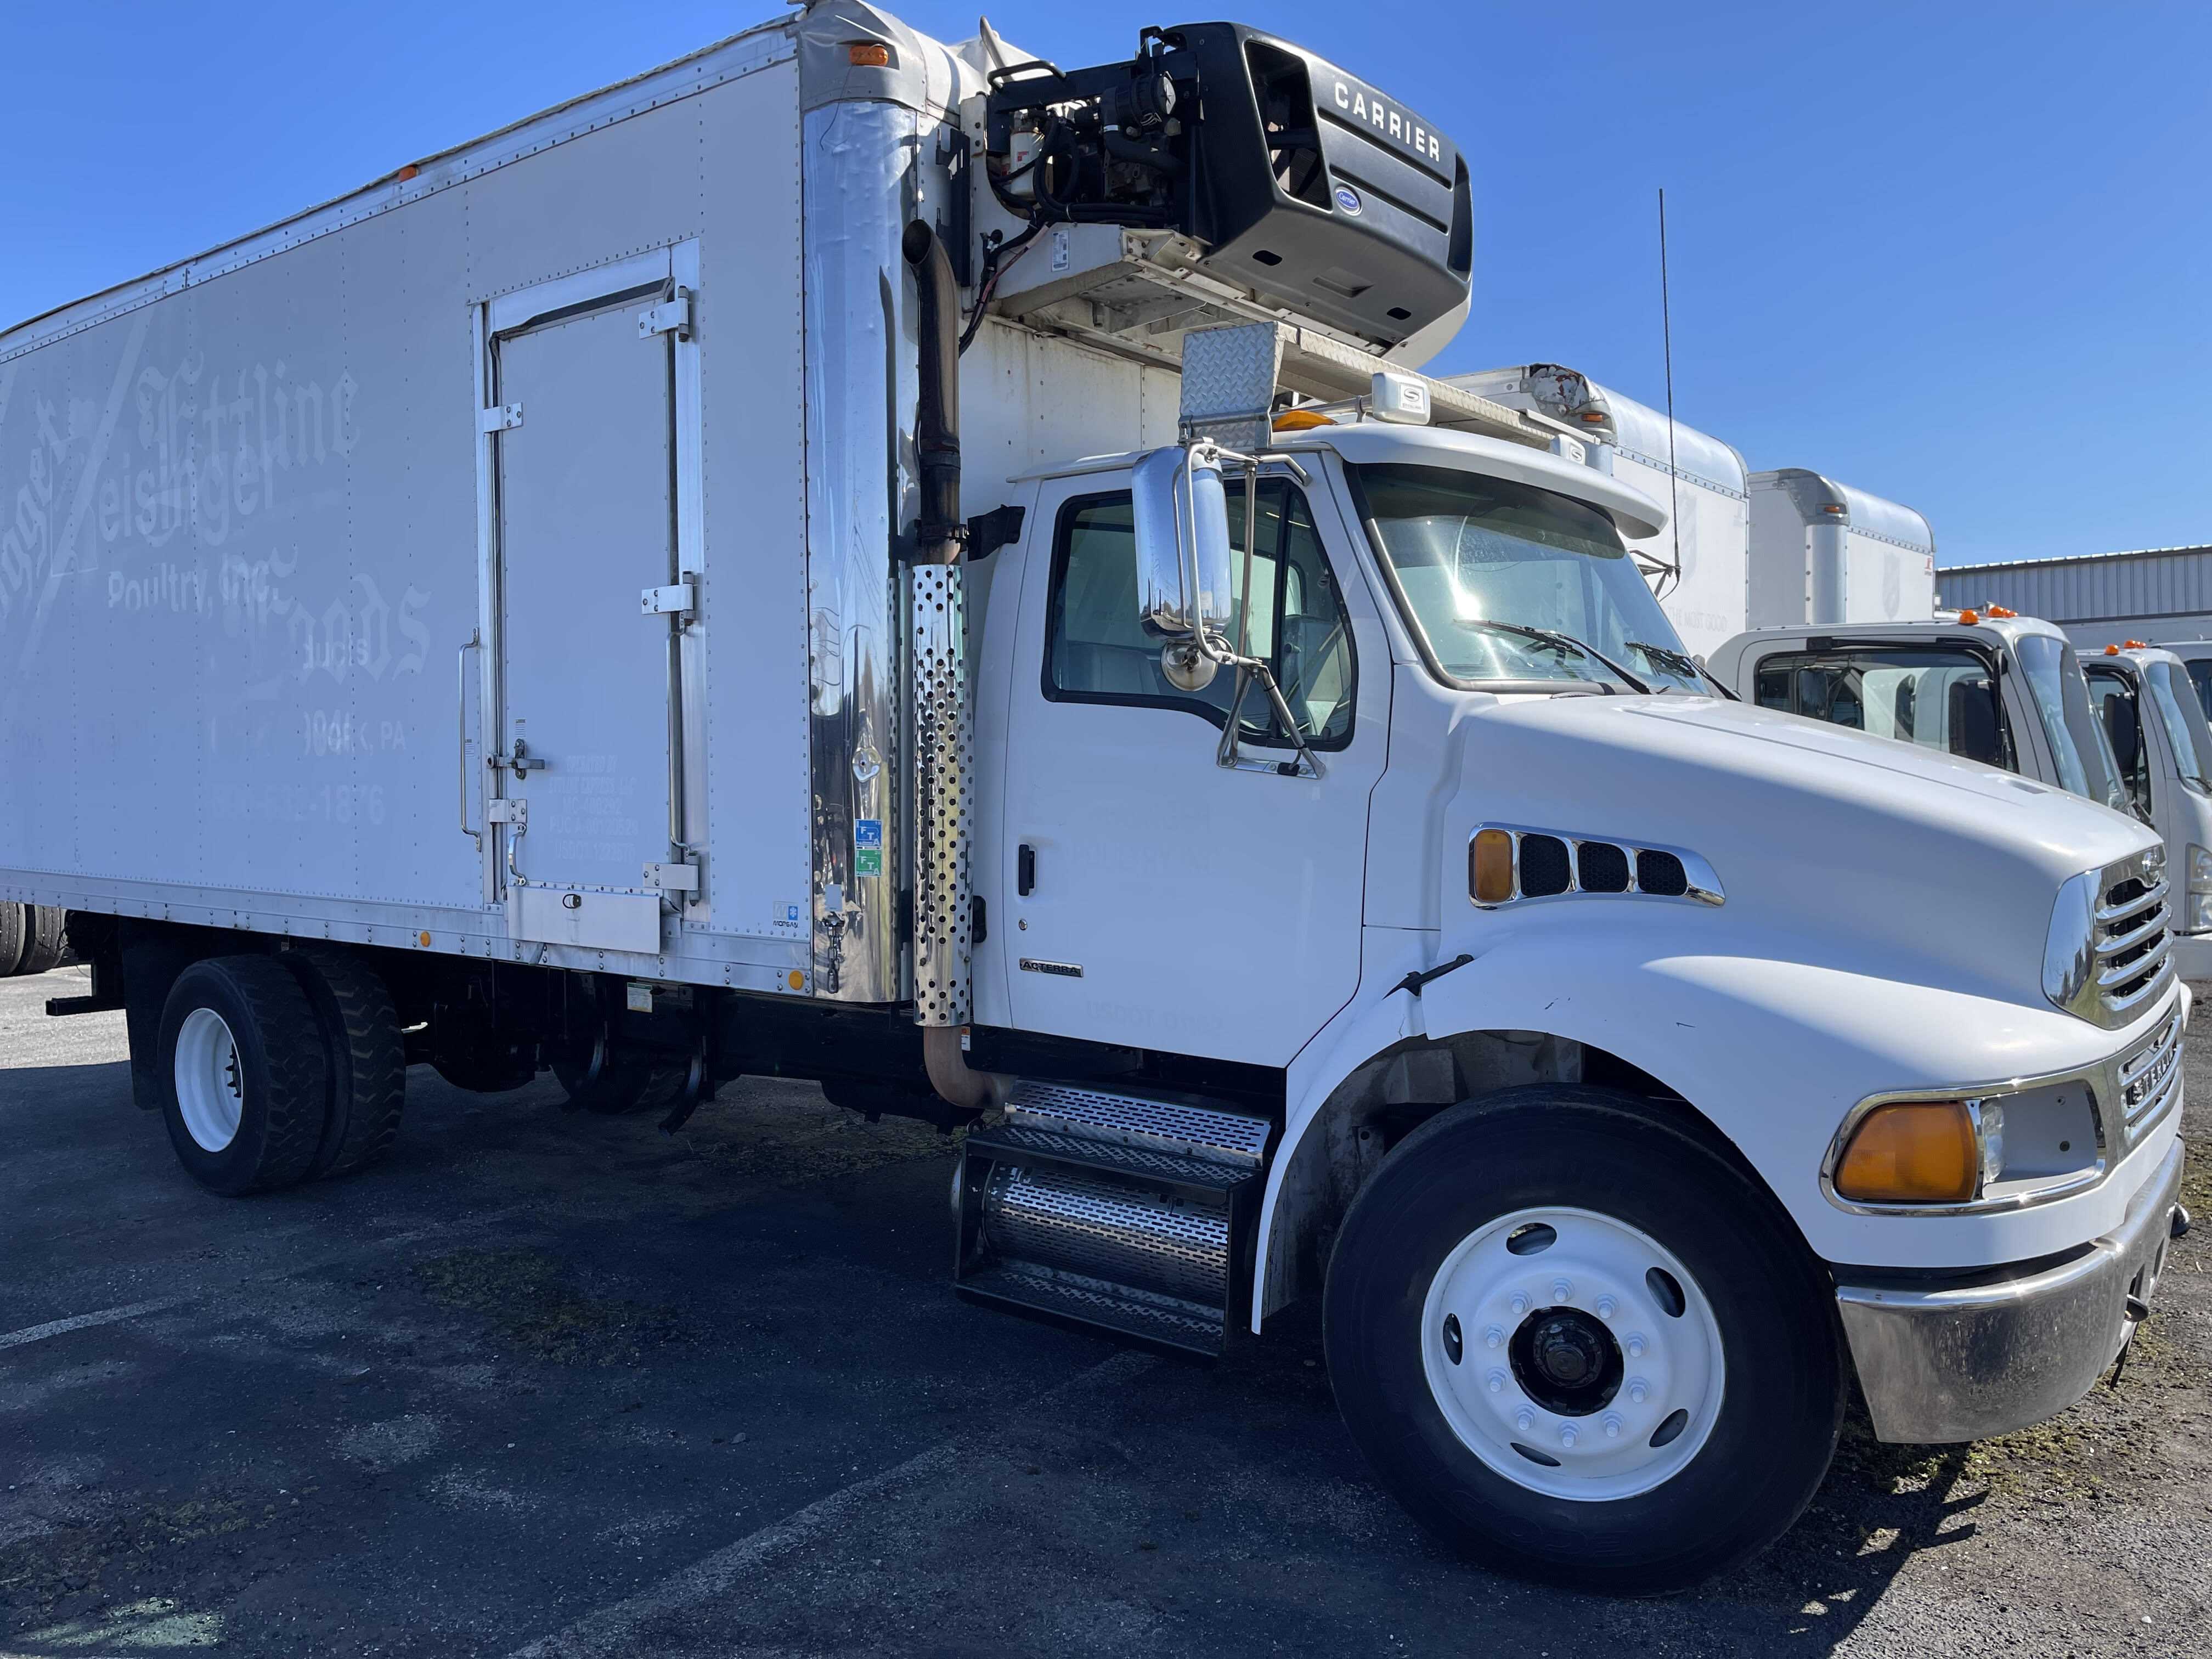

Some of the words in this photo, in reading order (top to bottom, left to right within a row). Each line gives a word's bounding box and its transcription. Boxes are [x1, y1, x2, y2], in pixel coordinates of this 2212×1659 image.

[1334, 81, 1440, 162] CARRIER
[1339, 192, 1356, 205] Carrier
[1707, 613, 1728, 632] GOOD
[1022, 961, 1079, 974] ACTERRA
